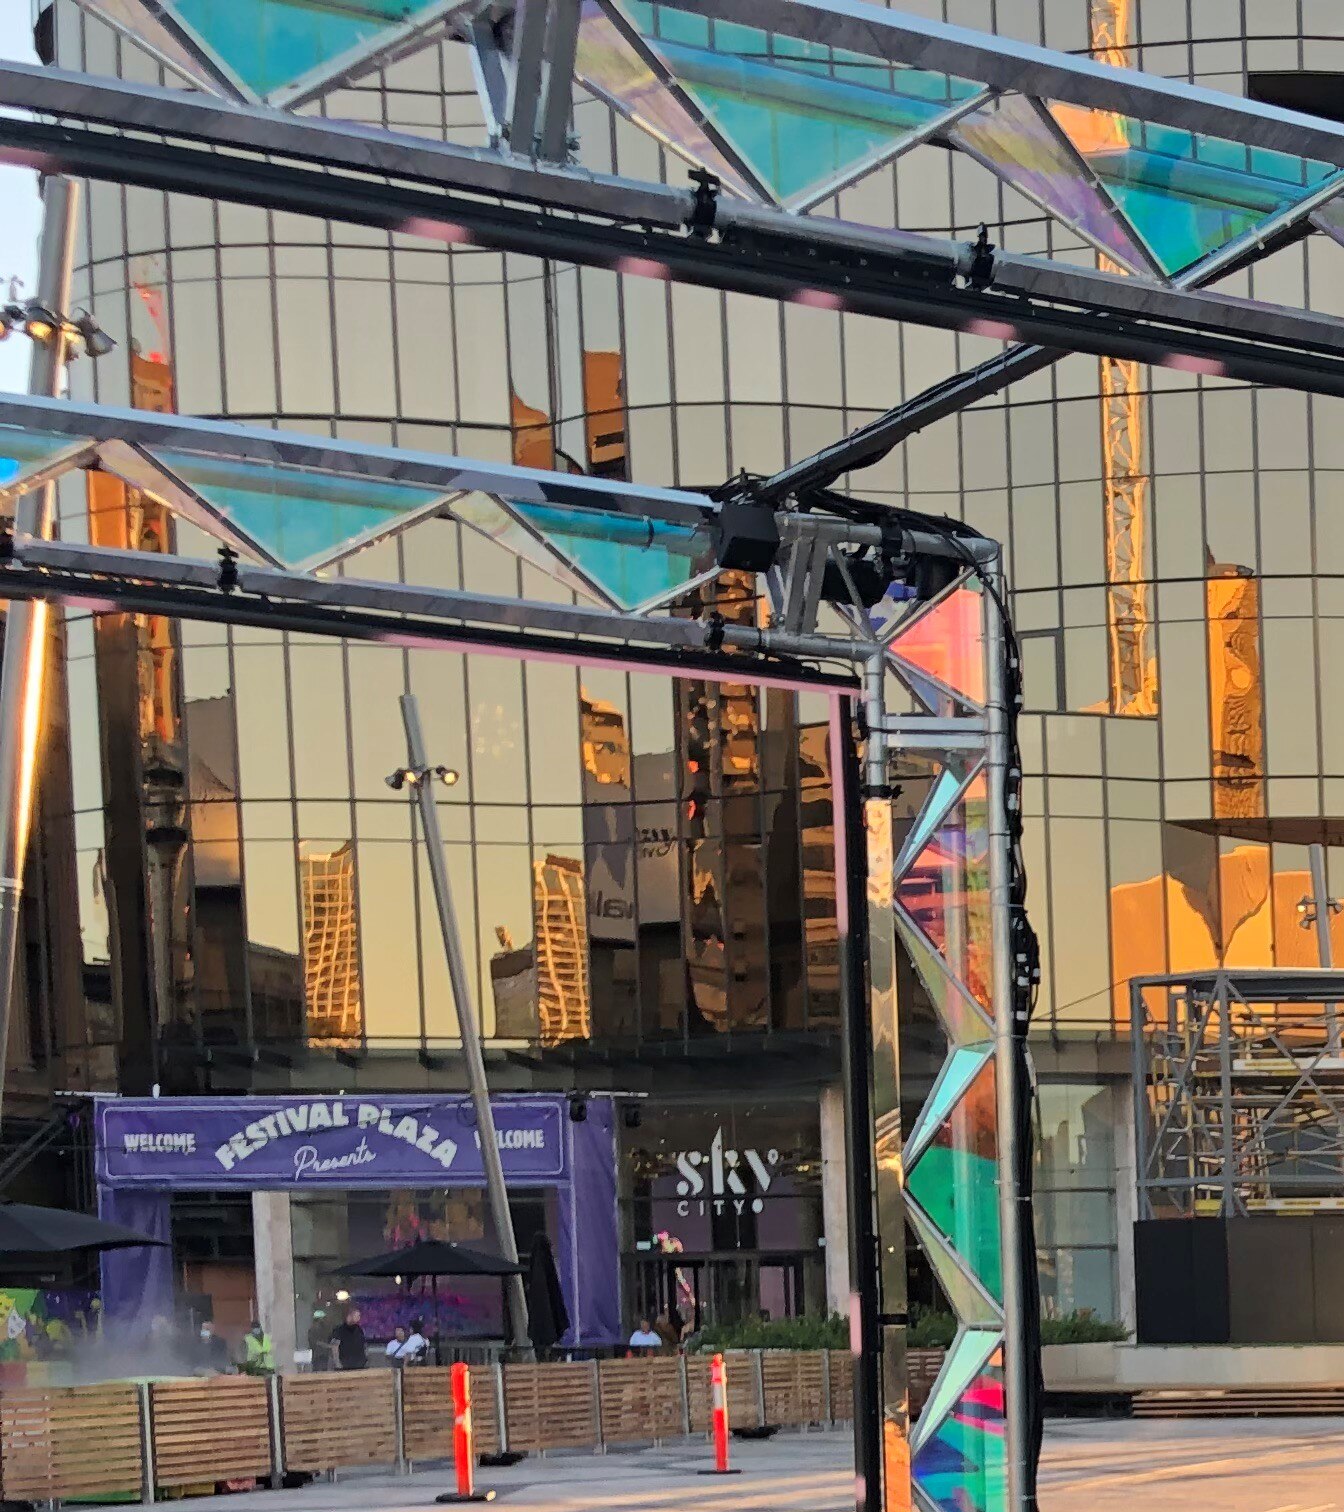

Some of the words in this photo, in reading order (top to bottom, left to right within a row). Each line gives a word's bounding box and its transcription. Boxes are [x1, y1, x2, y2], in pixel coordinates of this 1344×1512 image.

[124, 1133, 197, 1155] WELCOME
[215, 1102, 349, 1171] FESTIVAL
[358, 1103, 457, 1168] PLAZA
[473, 1129, 545, 1151] LCOME
[293, 1136, 377, 1181] Presents
[677, 1200, 746, 1217] CITY
